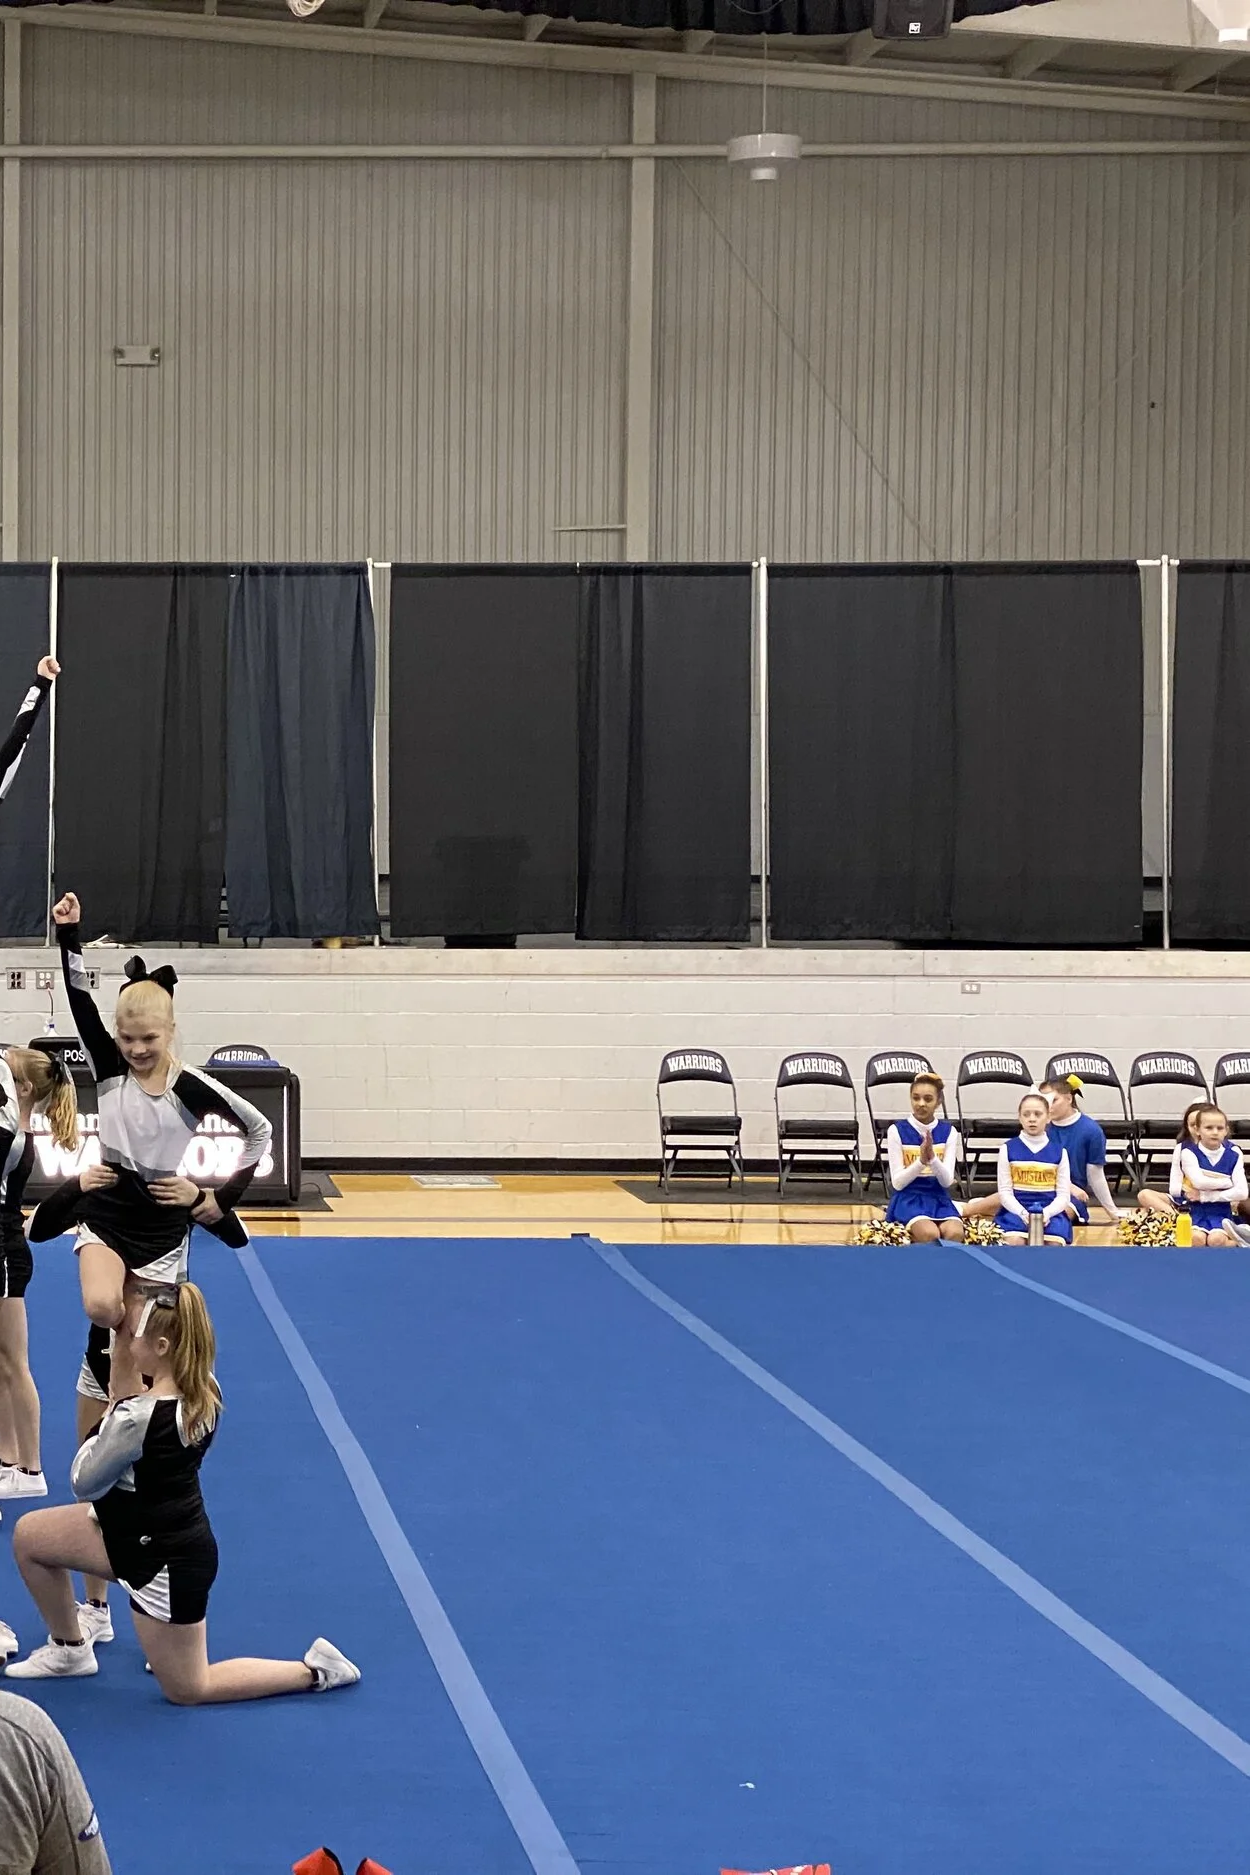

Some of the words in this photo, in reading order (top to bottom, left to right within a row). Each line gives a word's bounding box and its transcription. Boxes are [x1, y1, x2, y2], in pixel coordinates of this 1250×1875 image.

[667, 1055, 722, 1073] WARRIORS
[785, 1058, 842, 1076] WARRIORS
[873, 1057, 929, 1076] WARRIORS
[966, 1057, 1023, 1075] WARRIORS
[1052, 1058, 1109, 1077] WARRIORS
[1138, 1057, 1195, 1076] WARRIORS
